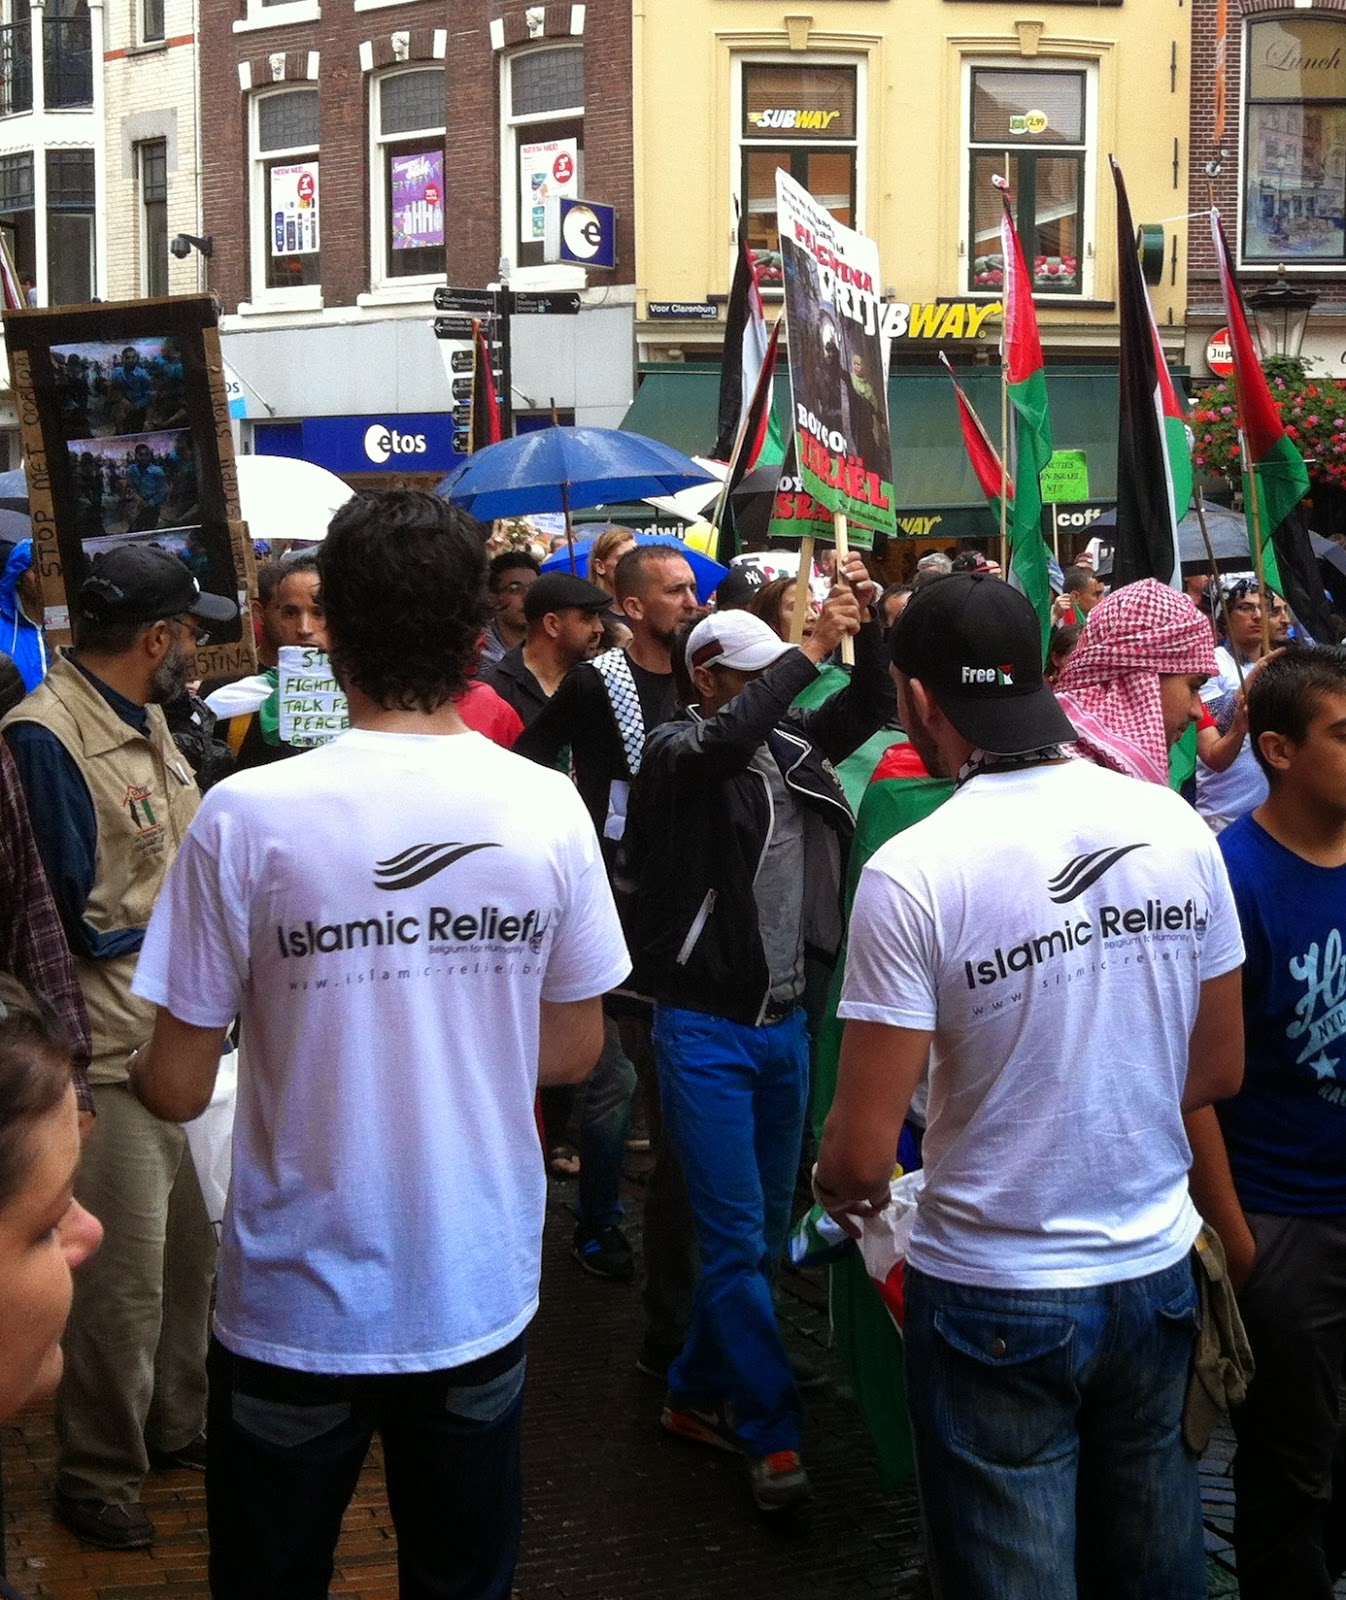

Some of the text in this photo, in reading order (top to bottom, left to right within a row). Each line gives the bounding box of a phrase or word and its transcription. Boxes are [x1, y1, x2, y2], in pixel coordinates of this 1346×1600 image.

[1264, 40, 1340, 72] Lunch
[755, 109, 840, 129] SUBWAY
[649, 303, 717, 315] Voor Clarenburg
[818, 264, 876, 336] VRIJ
[26, 442, 51, 491] MET
[34, 510, 62, 578] STOP
[961, 666, 996, 684] Free
[283, 700, 323, 714] TALK
[293, 716, 350, 731] PEACE
[276, 906, 537, 959] Islamic Relief
[964, 898, 1192, 990] Islamic Relief
[1318, 1009, 1346, 1042] NYC
